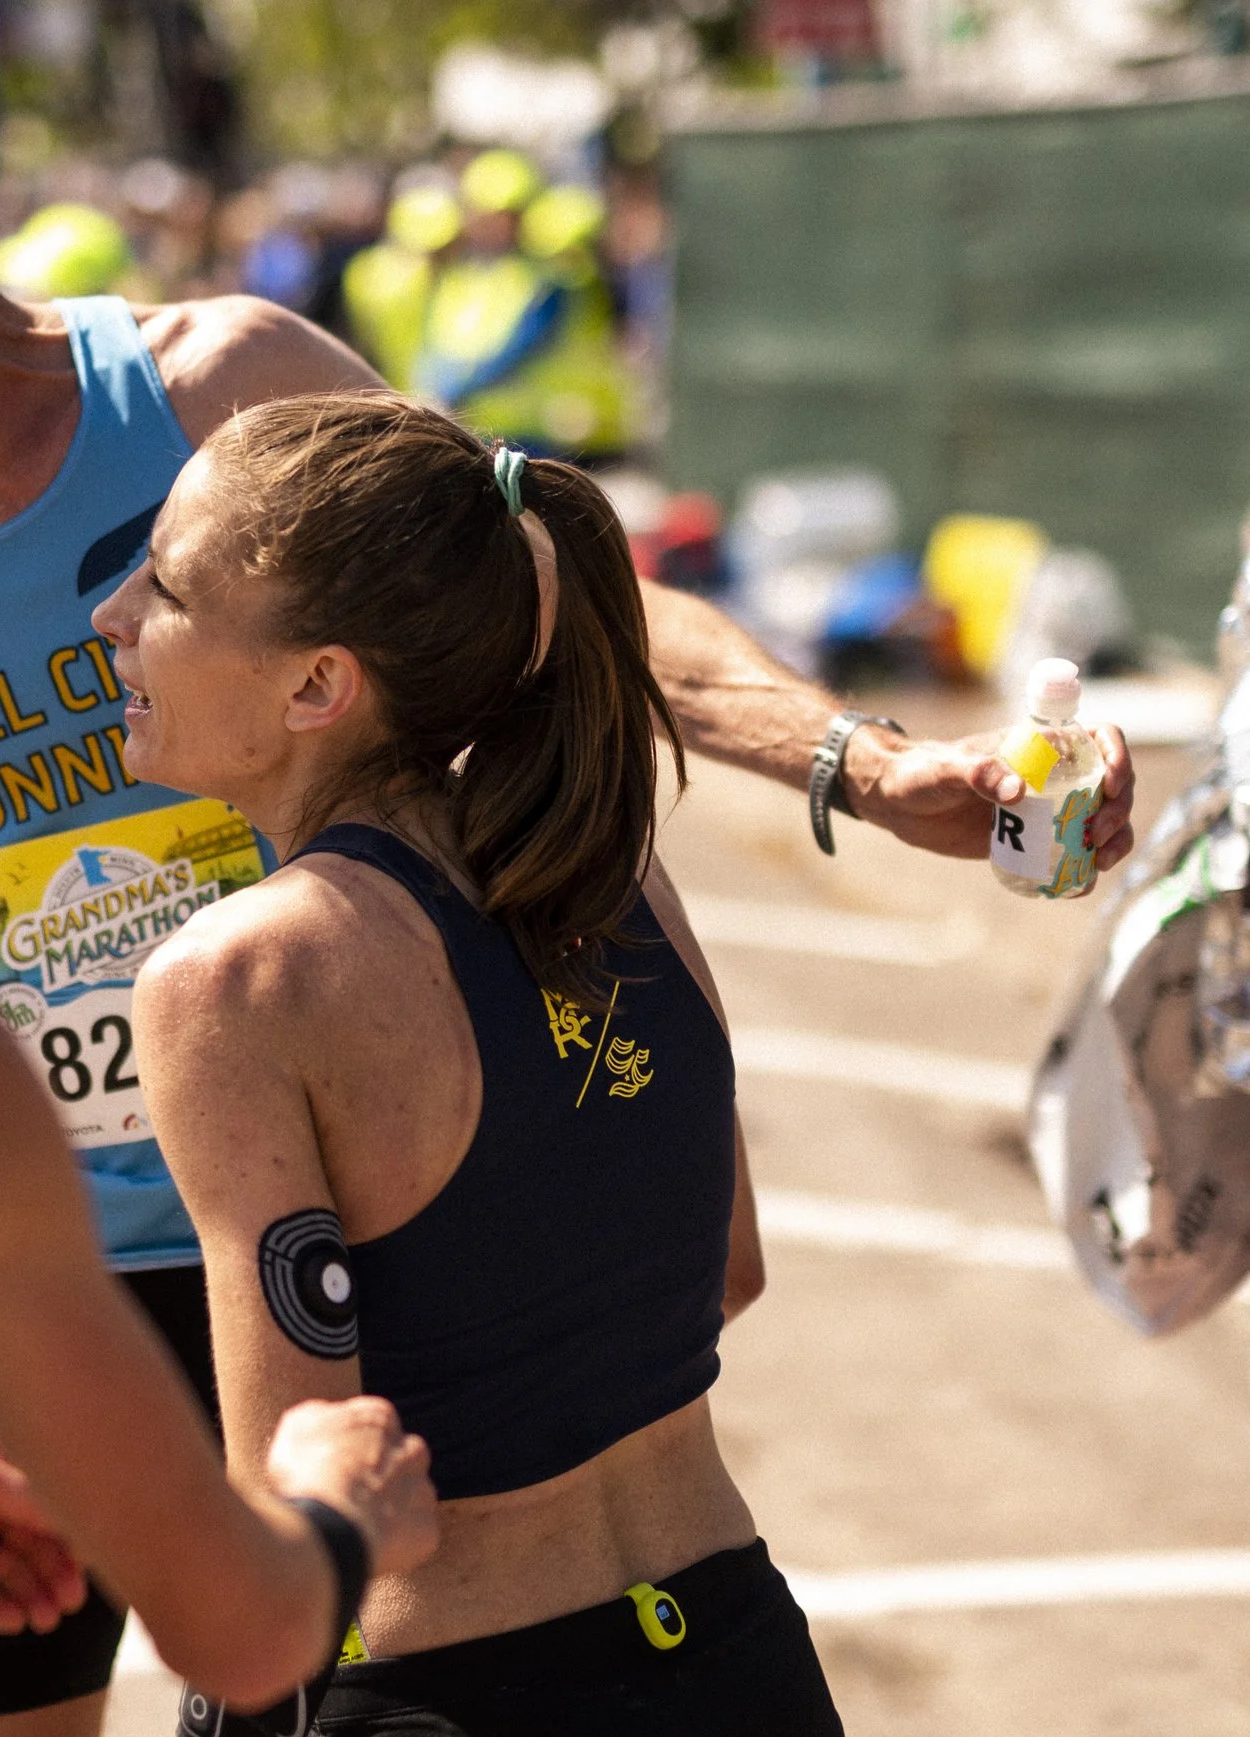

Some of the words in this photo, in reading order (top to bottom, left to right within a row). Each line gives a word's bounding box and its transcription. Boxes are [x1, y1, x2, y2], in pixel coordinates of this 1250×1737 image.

[47, 634, 123, 714] CI
[991, 803, 1026, 853] R
[7, 862, 192, 963] GRANDMA'S
[45, 885, 217, 986] MARATHON
[41, 1015, 140, 1103] 82
